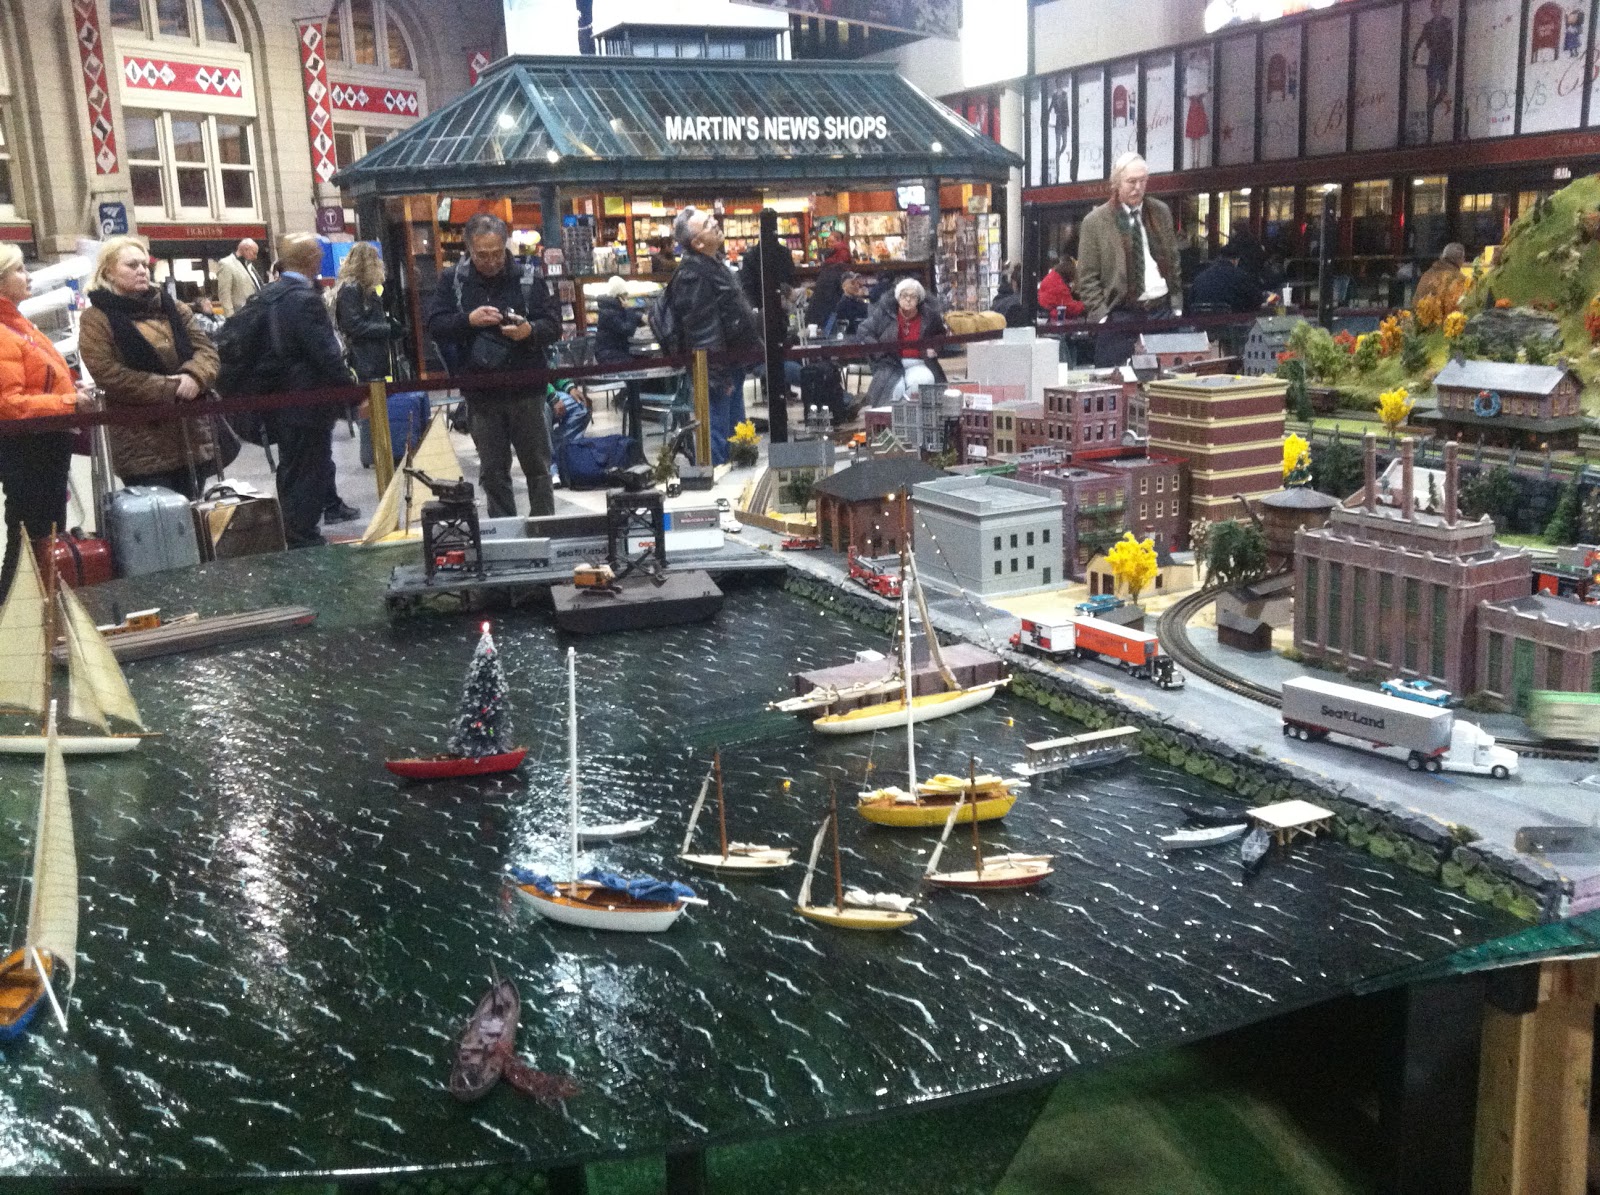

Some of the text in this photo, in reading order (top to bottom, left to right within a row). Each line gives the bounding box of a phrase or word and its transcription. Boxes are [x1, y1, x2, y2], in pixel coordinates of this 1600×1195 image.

[665, 115, 887, 141] MARTIN'S NEWS SHOPS
